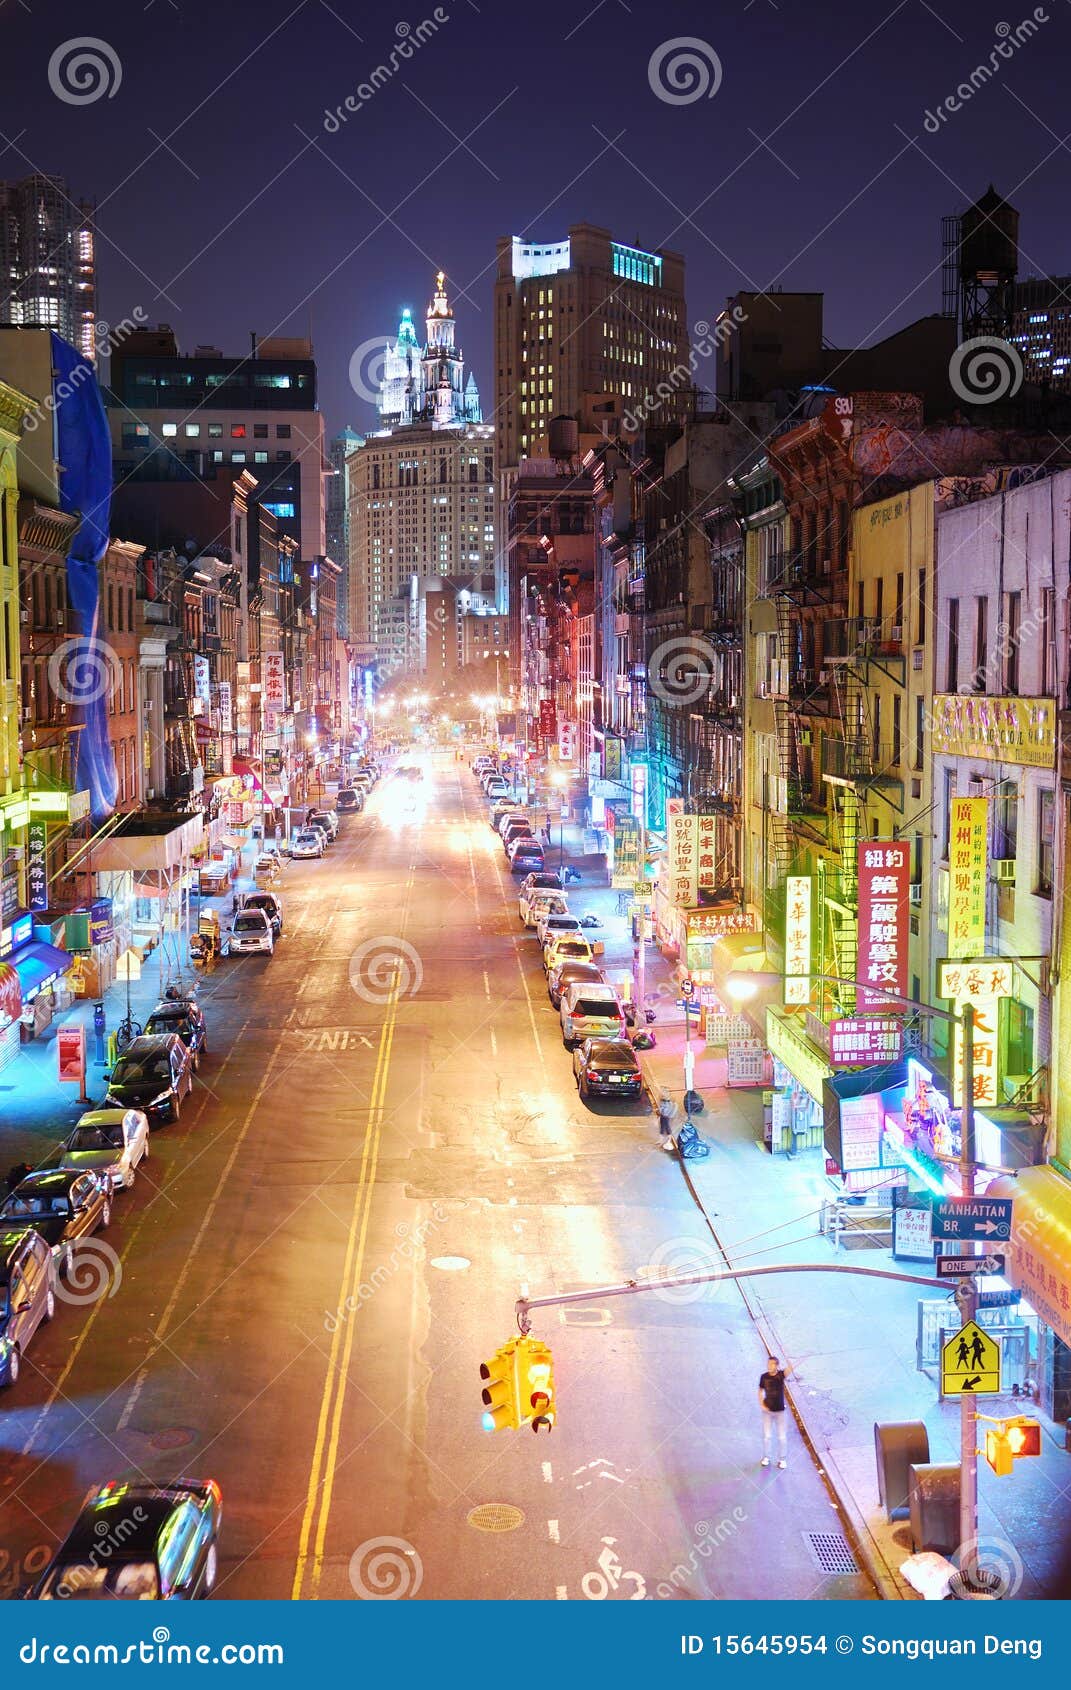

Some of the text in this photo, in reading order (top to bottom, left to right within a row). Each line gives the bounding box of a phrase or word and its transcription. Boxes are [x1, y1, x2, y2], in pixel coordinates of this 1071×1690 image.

[864, 850, 904, 868] 紐約
[954, 803, 973, 939] 廣州駕駛學校
[867, 876, 899, 983] 第一駕駛學校
[938, 1203, 1006, 1218] MANHATTAN
[943, 1220, 961, 1232] BR.
[946, 1261, 995, 1271] ONE WAY
